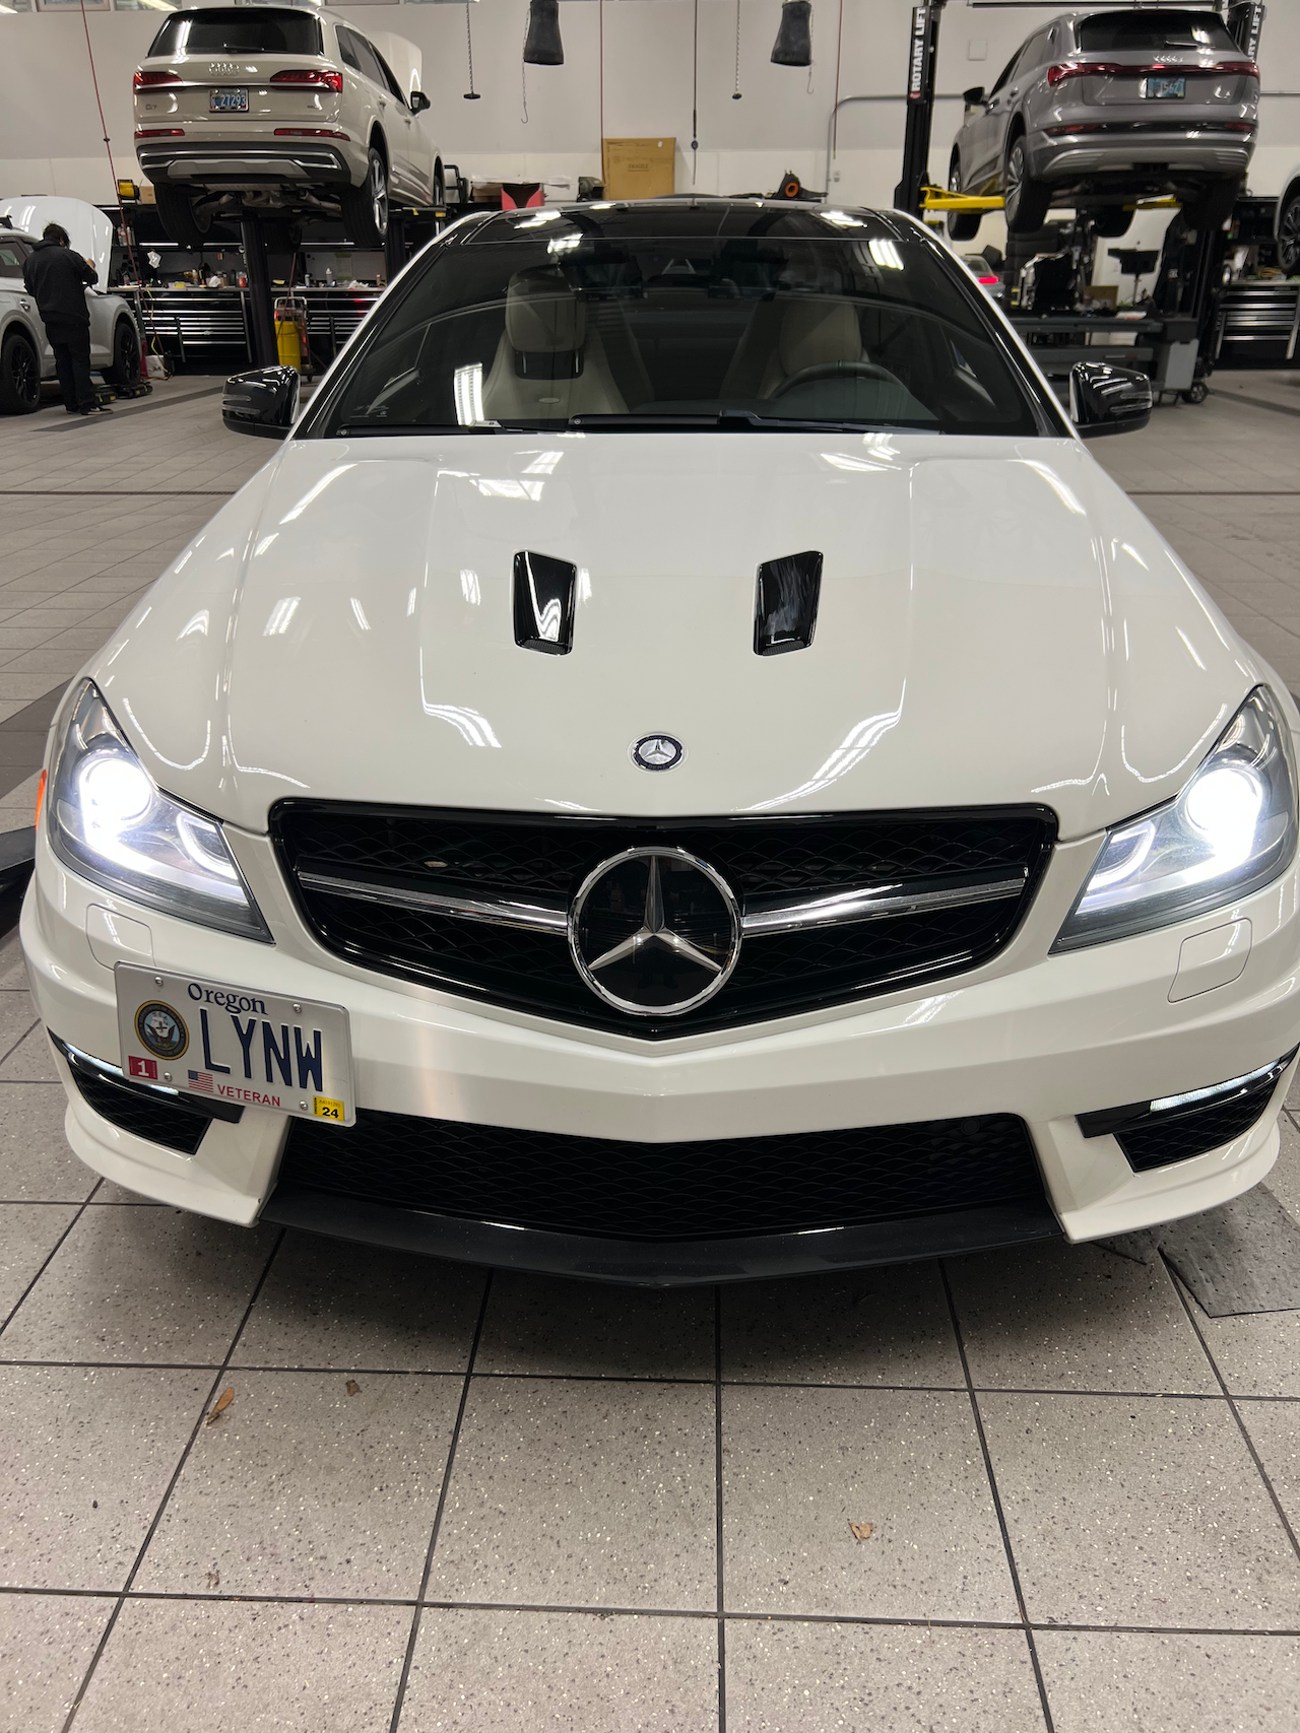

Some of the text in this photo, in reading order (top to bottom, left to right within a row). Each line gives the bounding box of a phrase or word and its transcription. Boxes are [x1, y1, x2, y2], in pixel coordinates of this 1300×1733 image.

[1251, 5, 1262, 34] LIFT
[911, 7, 926, 92] ROTARY LIFT
[187, 983, 268, 1015] Oregon
[200, 1008, 323, 1092] LYNW
[137, 1060, 150, 1077] 1
[217, 1084, 281, 1107] VETERAN
[322, 1106, 339, 1119] 24
